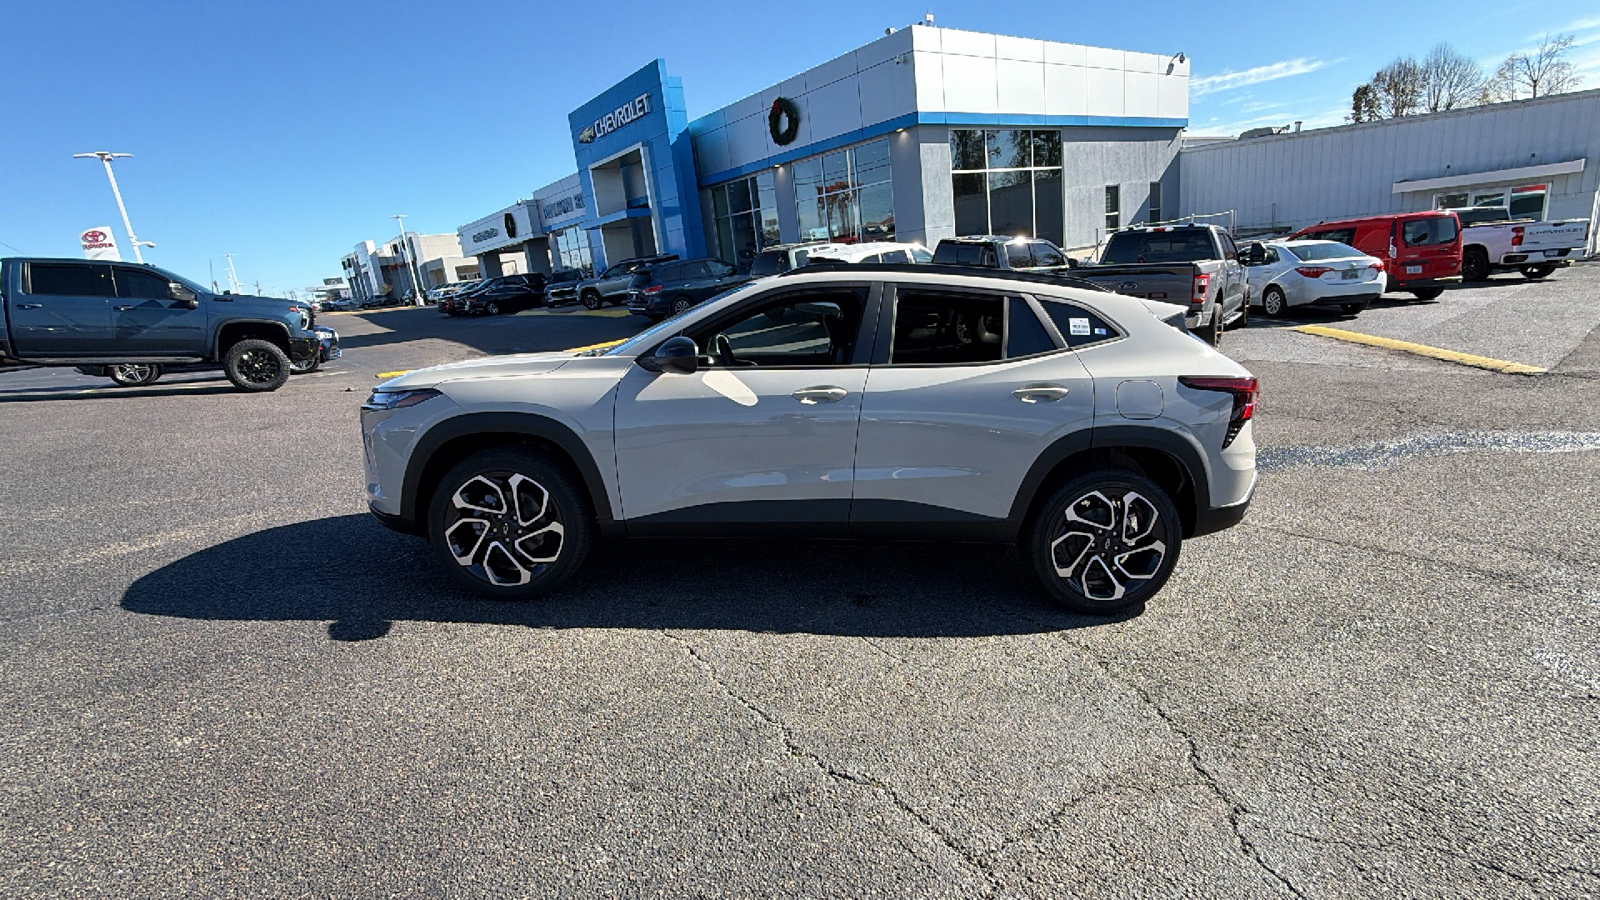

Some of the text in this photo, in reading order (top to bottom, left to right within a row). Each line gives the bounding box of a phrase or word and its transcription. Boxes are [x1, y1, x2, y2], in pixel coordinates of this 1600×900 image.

[594, 93, 650, 138] CHEVROLET
[1529, 227, 1584, 236] CHEVROLET
[82, 242, 114, 250] TOYOTA
